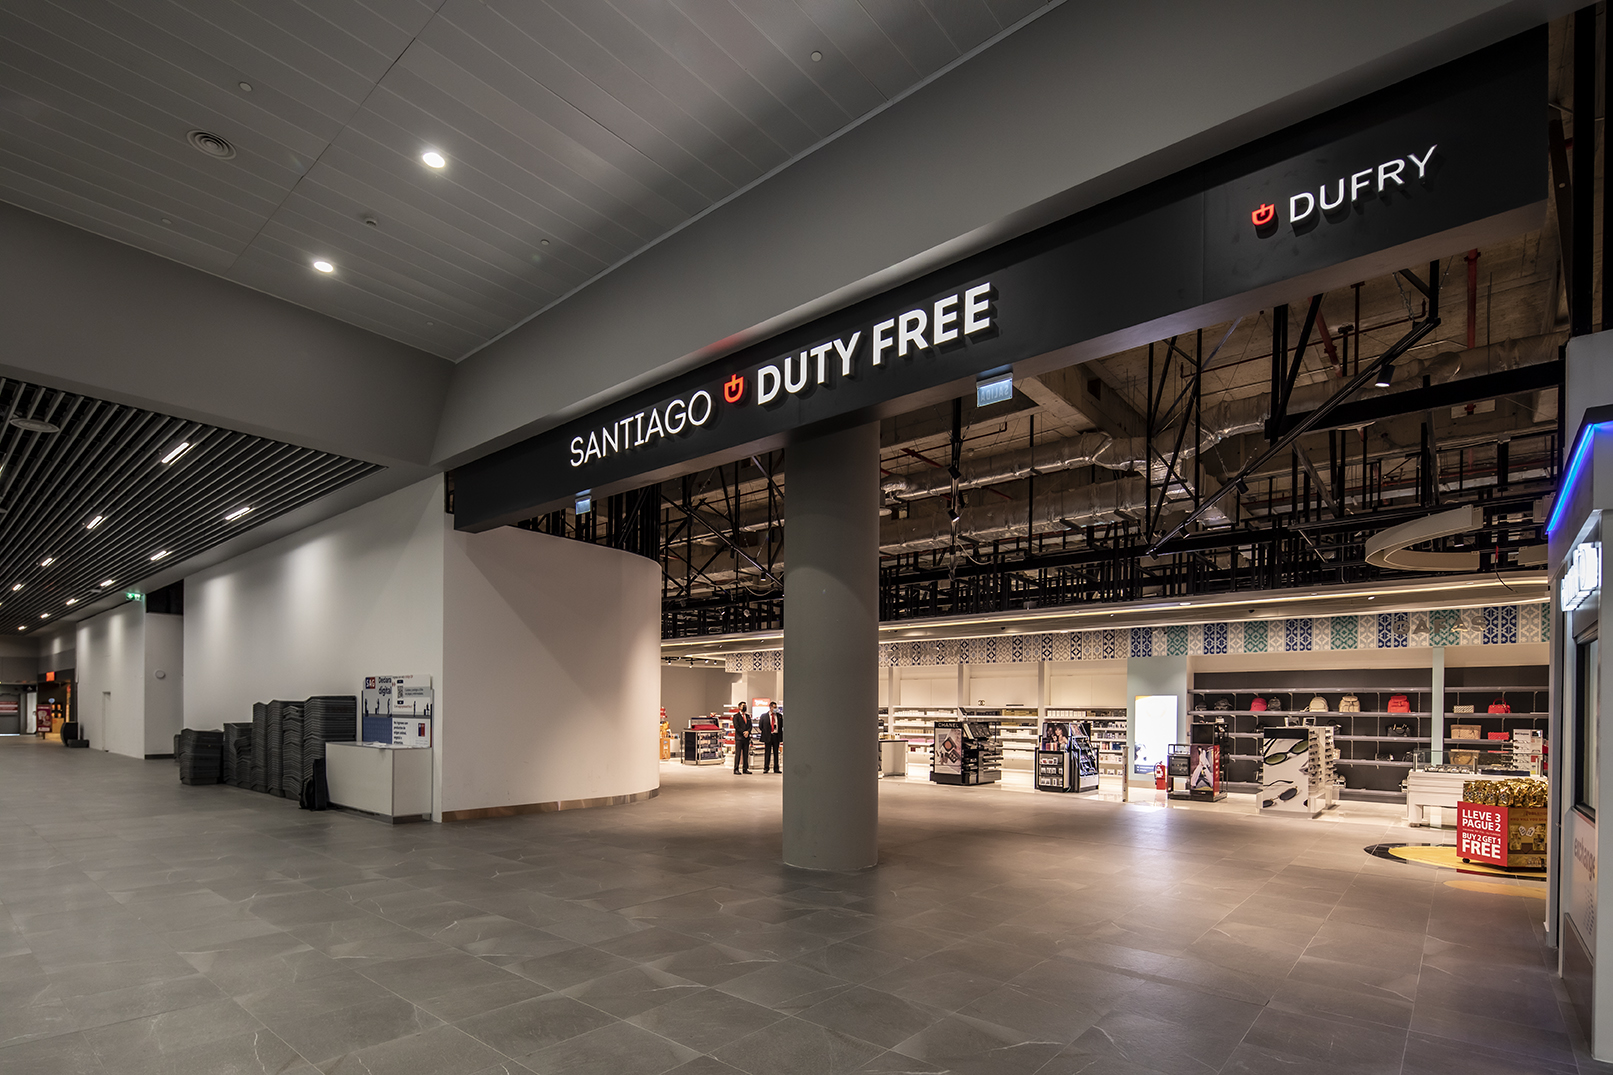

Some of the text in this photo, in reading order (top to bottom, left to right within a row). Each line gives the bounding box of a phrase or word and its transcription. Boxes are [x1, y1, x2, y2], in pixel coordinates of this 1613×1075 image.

[1289, 144, 1438, 224] DUFRY
[569, 282, 991, 468] SANTIAGO DUTY FREE
[366, 679, 376, 687] SAG
[1462, 808, 1501, 823] LLEVE 3
[1462, 818, 1501, 832] PAGUE 2
[1462, 832, 1477, 841] BUY
[1477, 834, 1482, 842] 2
[1482, 835, 1497, 844] GET
[1462, 839, 1501, 859] FREE
